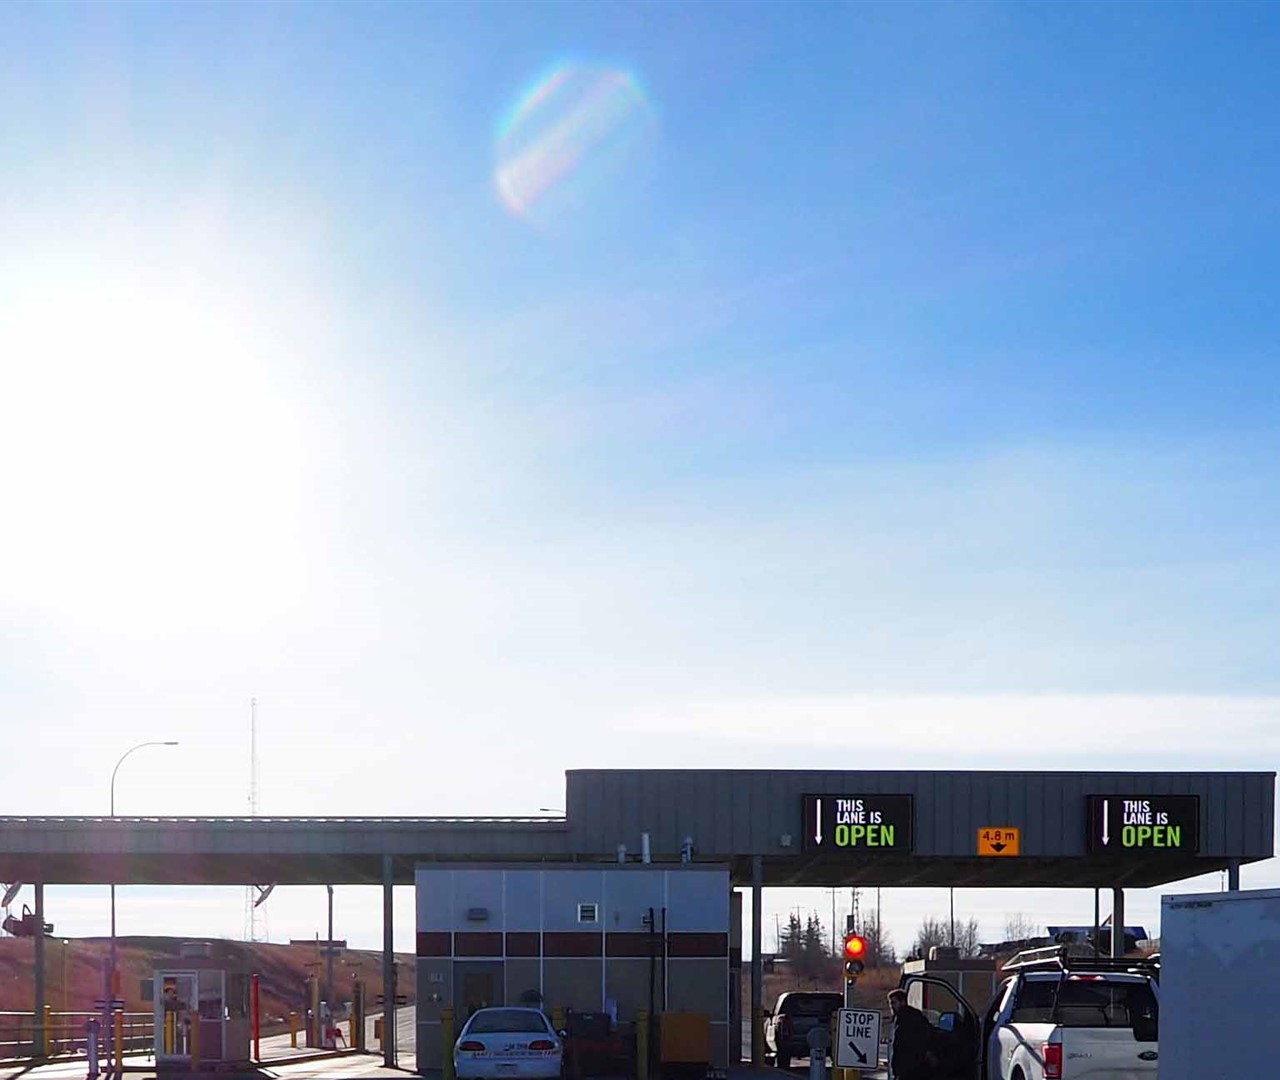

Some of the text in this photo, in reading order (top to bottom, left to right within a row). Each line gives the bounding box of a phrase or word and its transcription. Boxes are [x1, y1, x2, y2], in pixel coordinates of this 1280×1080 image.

[836, 799, 864, 812] THIS
[1123, 800, 1151, 813] THIS
[836, 812, 882, 824] LANE IS
[1123, 812, 1169, 825] LANE IS
[835, 825, 895, 847] OPEN
[982, 830, 1015, 841] 4.8 m
[1122, 826, 1181, 848] OPEN
[845, 1012, 874, 1025] STOP
[846, 1025, 872, 1039] LINE
